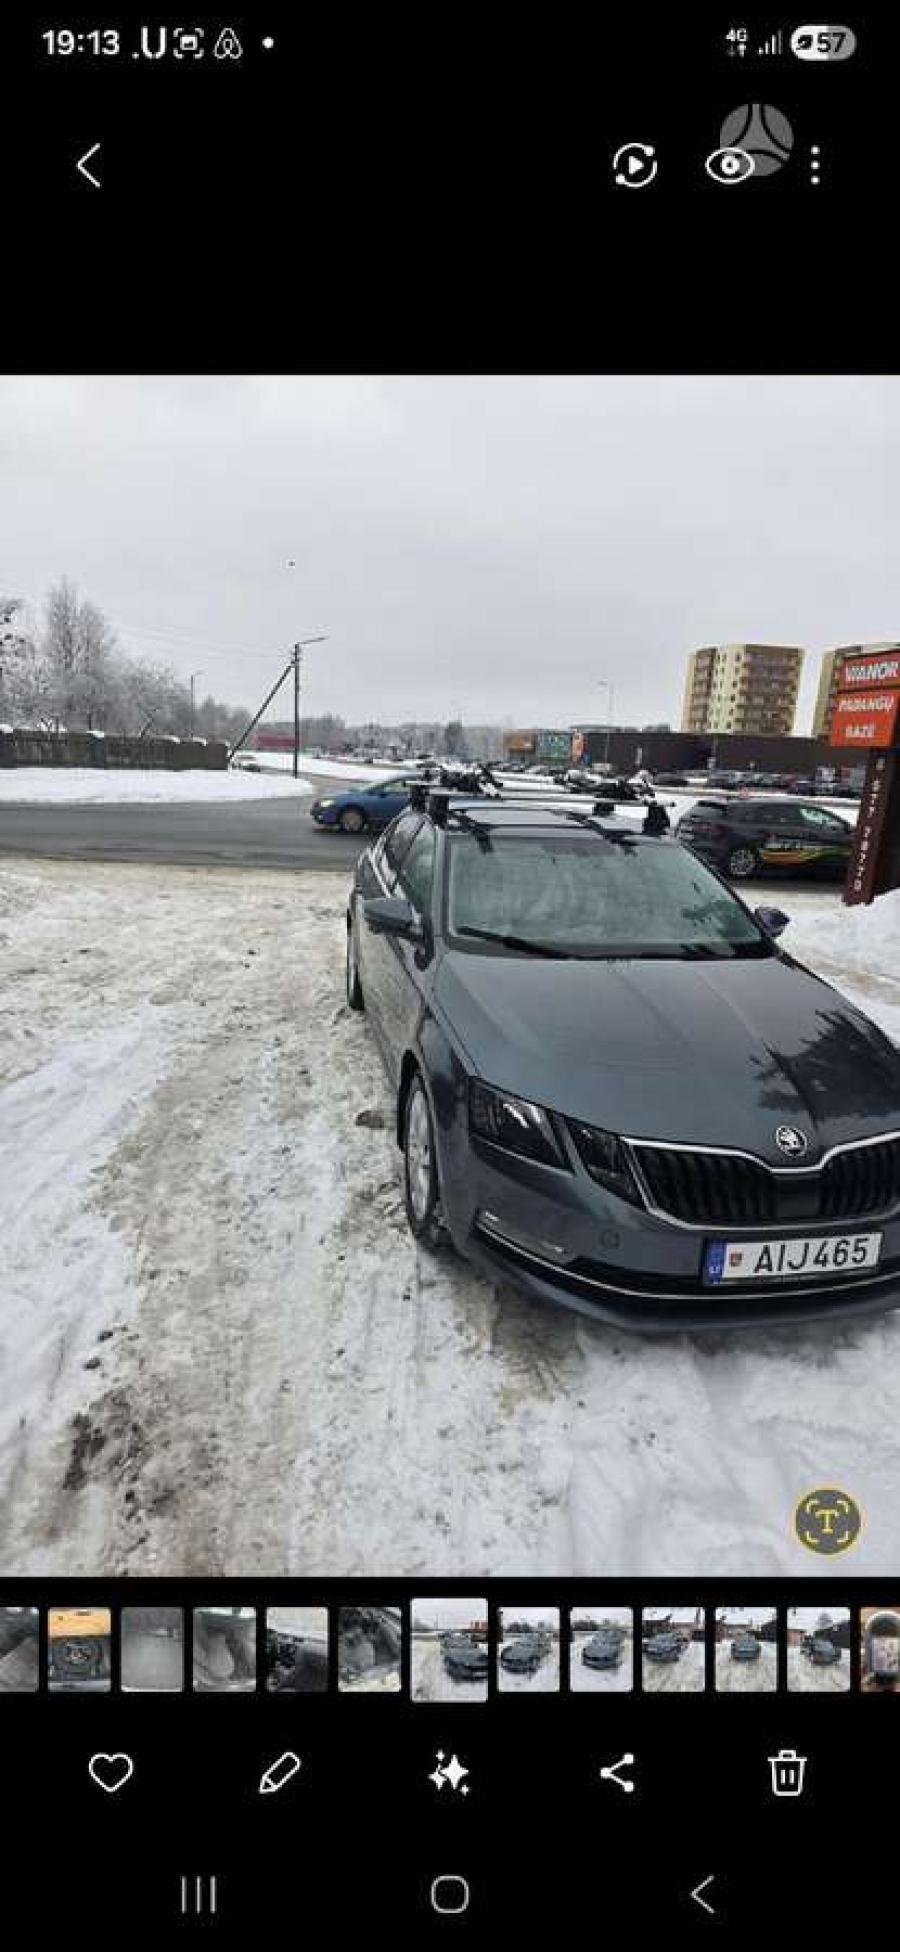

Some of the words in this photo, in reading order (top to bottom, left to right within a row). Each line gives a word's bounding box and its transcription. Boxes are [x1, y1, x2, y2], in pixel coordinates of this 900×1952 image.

[42, 29, 120, 55] 19:13
[725, 28, 747, 41] 4G
[817, 32, 846, 53] 57
[753, 1238, 868, 1273] AIJ465
